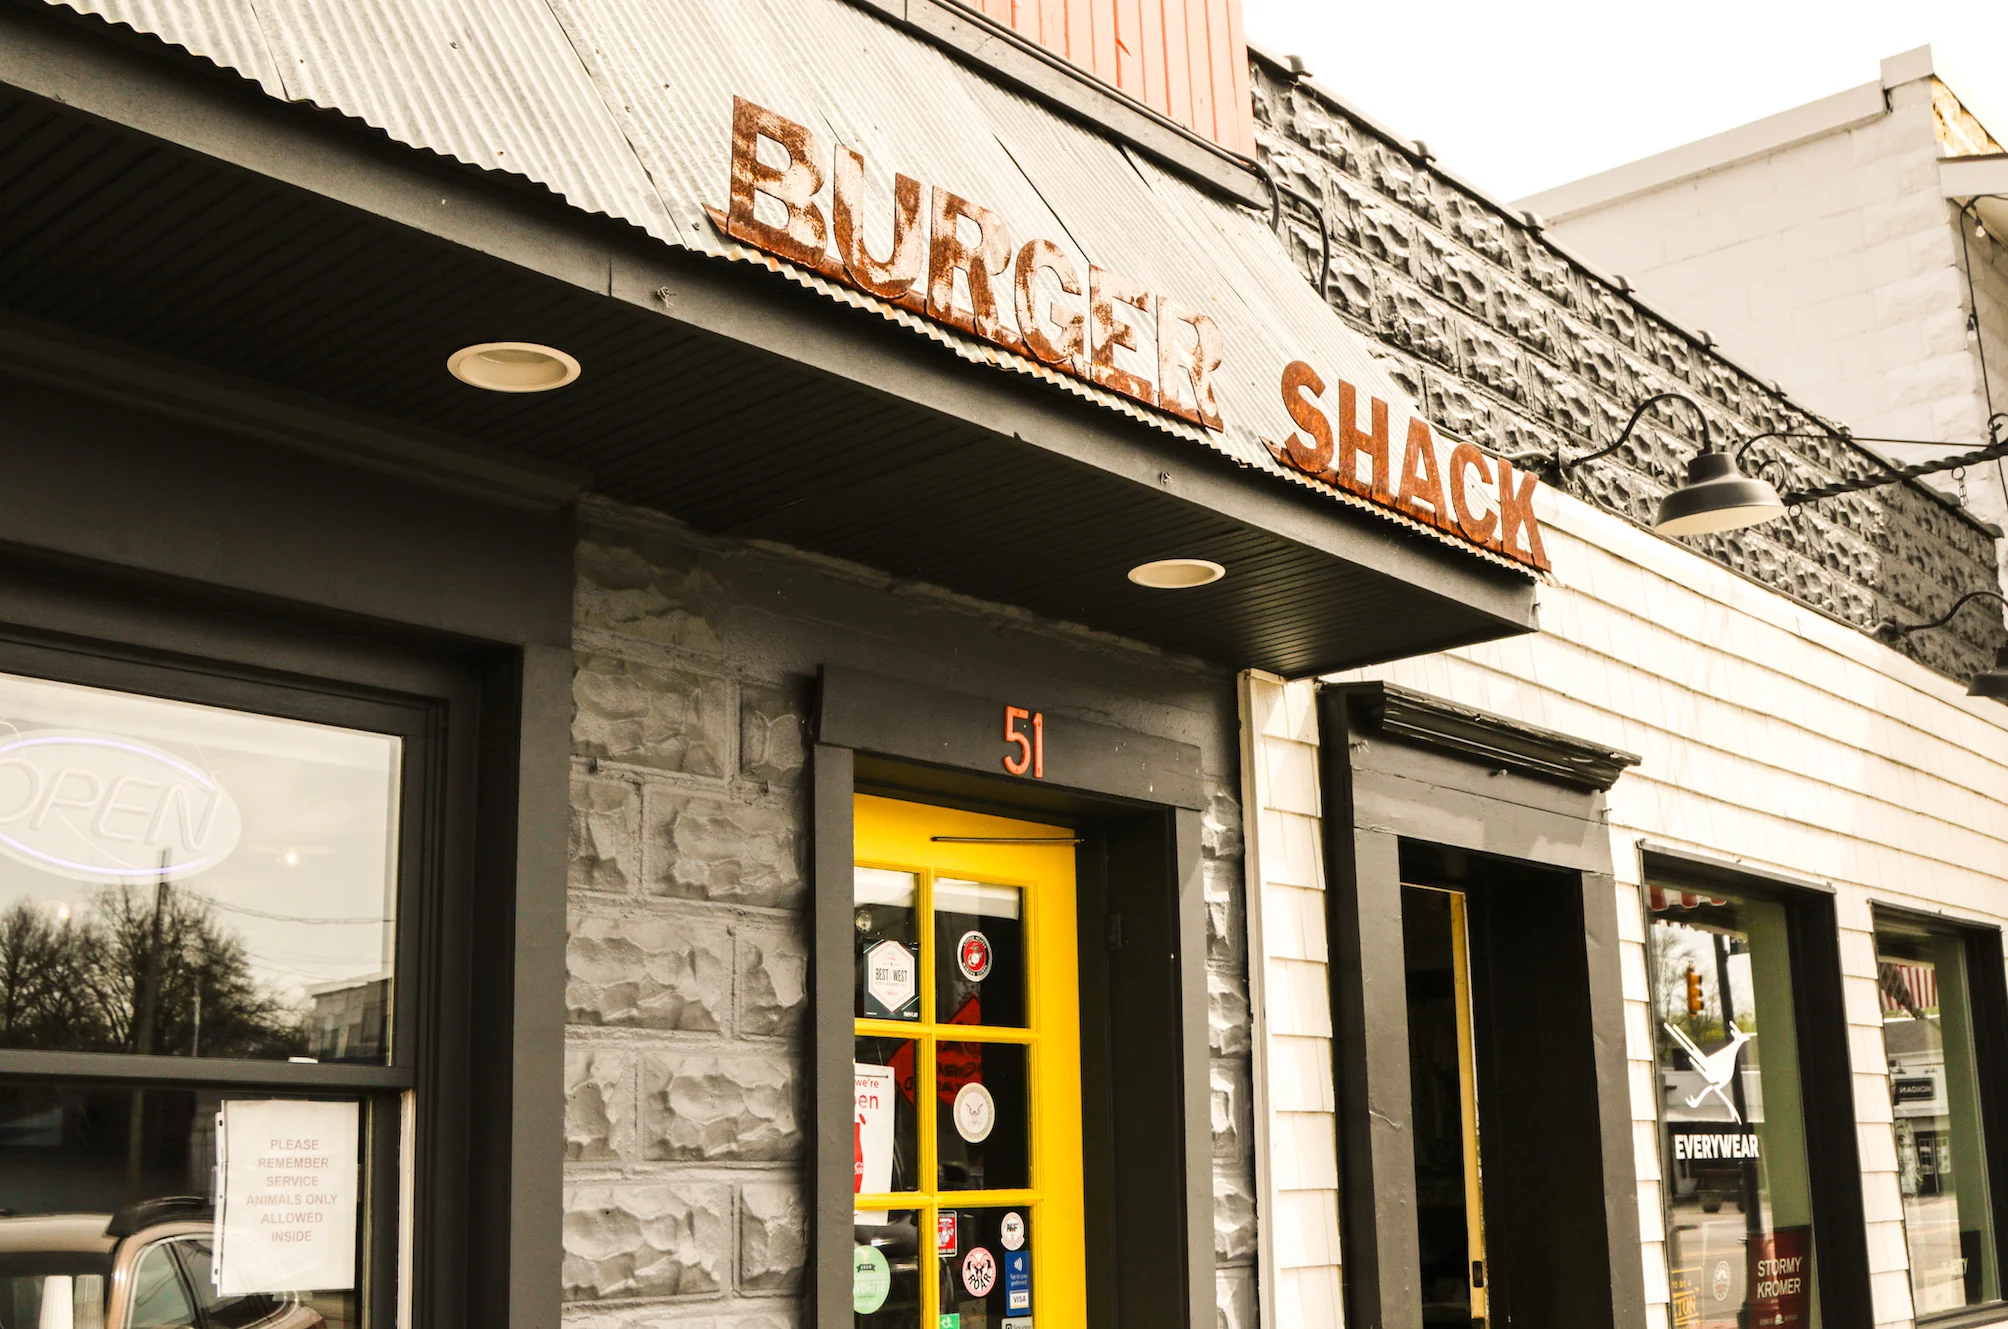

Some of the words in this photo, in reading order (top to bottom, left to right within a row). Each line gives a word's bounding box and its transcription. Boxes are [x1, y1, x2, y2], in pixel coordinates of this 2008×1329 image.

[727, 95, 1223, 433] BURGER
[1281, 360, 1551, 572] SHACK
[1003, 705, 1044, 778] 51
[875, 968, 889, 981] BEST
[893, 970, 908, 983] WEST
[854, 1094, 879, 1110] en
[270, 1139, 319, 1151] PLEASE
[1674, 1133, 1760, 1160] EVERYWEAR
[258, 1157, 329, 1169] REMEMBER
[266, 1175, 319, 1187] SERVICE
[246, 1194, 302, 1206] ANIMALS
[305, 1193, 338, 1205] ONLY
[261, 1212, 323, 1224] ALLOWED
[271, 1230, 313, 1243] INSIDE
[1757, 1256, 1803, 1278] STORMY
[968, 1273, 992, 1291] ROAR
[1757, 1277, 1802, 1299] KROMER
[1013, 1295, 1027, 1303] VISA
